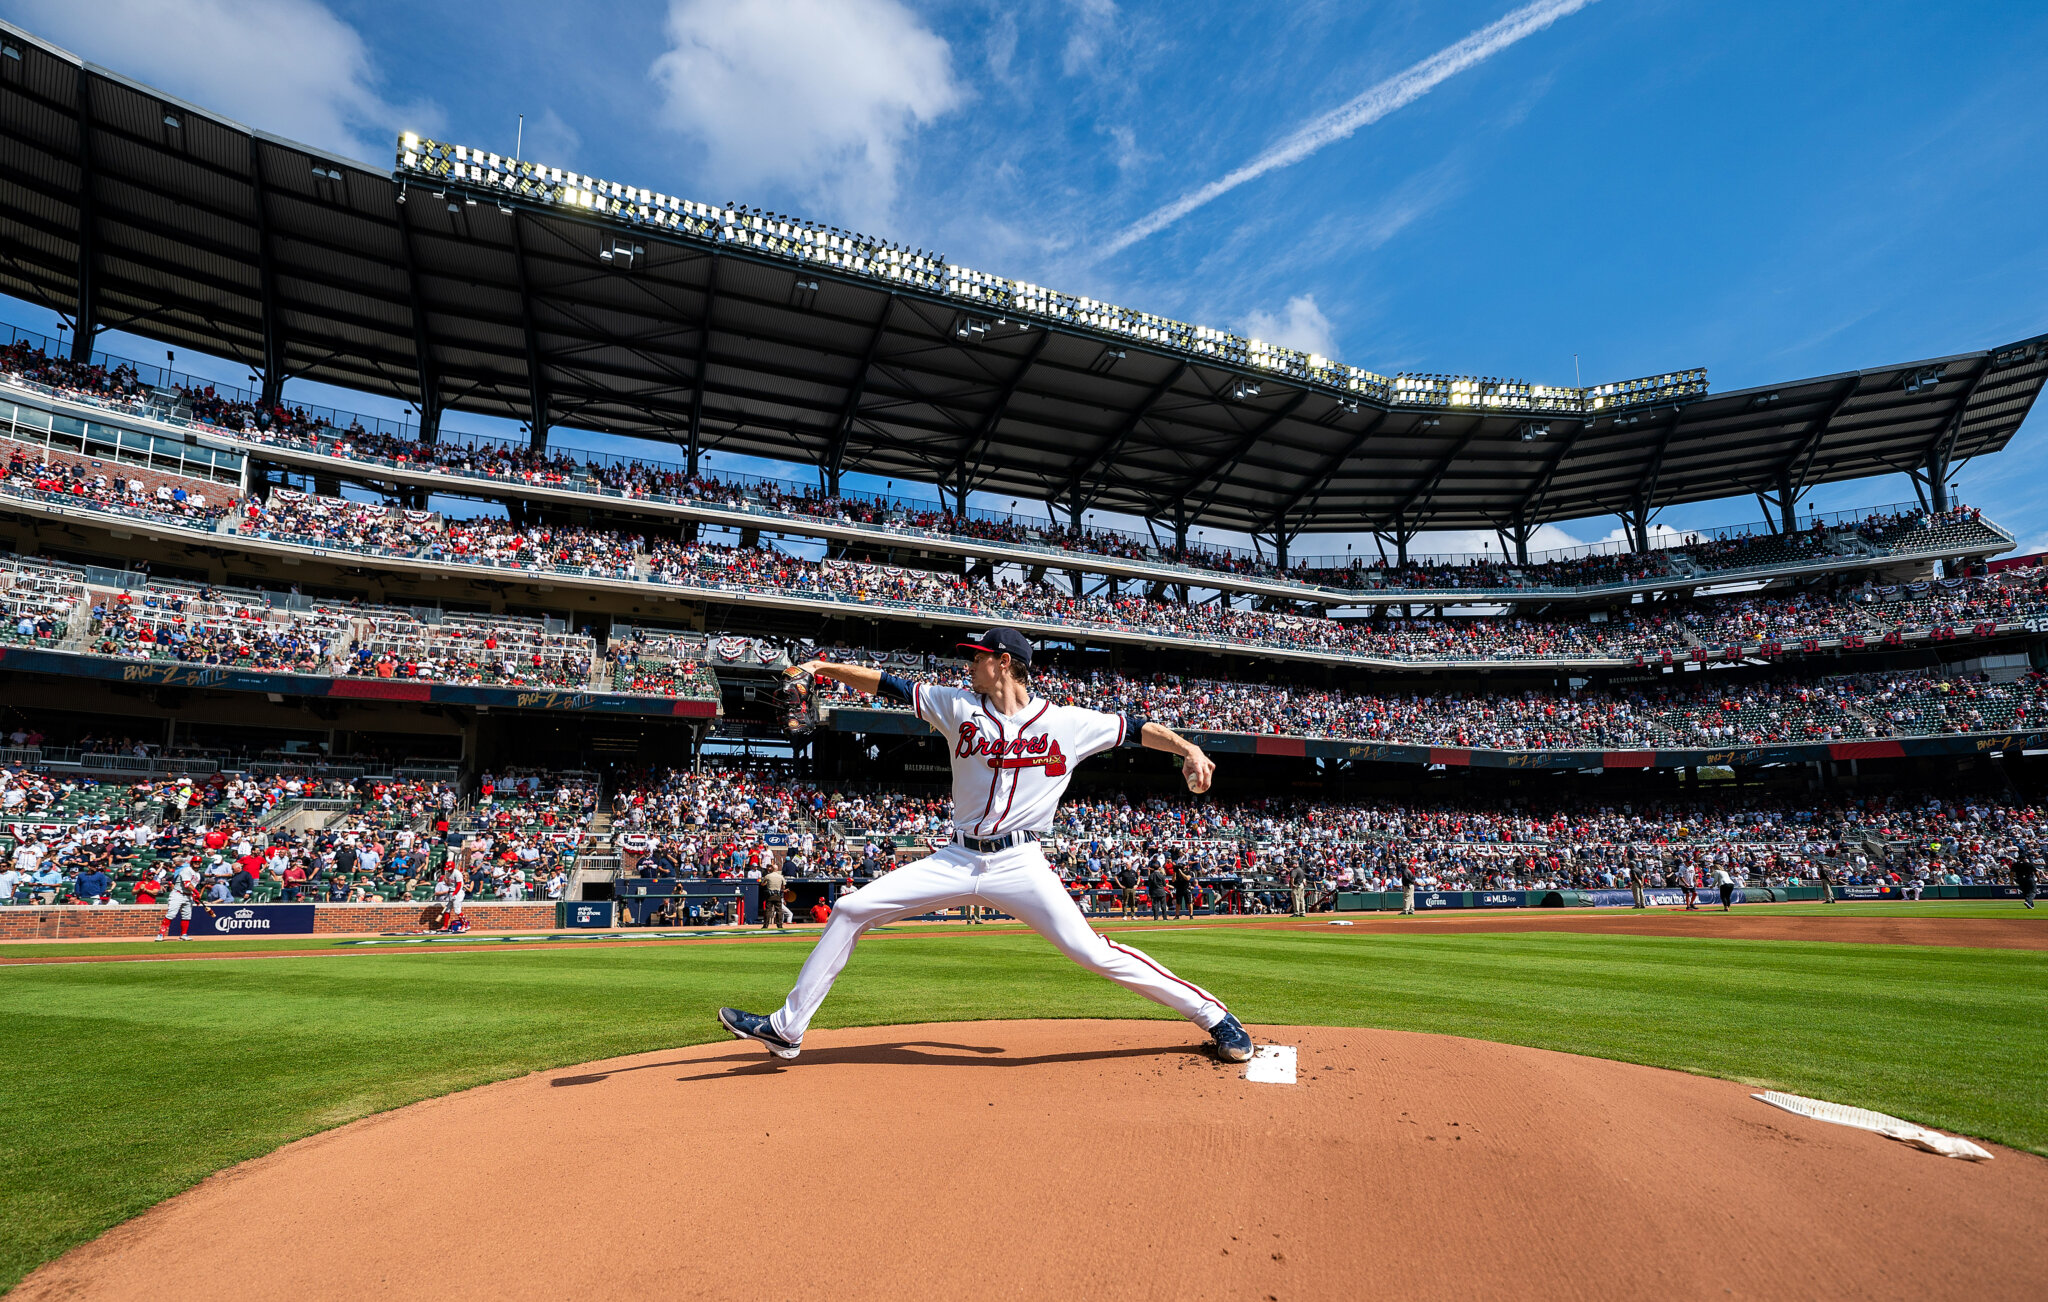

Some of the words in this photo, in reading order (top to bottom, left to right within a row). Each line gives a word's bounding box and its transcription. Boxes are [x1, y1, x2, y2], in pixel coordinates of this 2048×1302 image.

[1973, 623, 1997, 637] 47
[2024, 618, 2048, 633] 42
[1884, 631, 1904, 645] 41
[1930, 626, 1957, 641] 44
[1801, 640, 1821, 652] 31
[1842, 635, 1865, 649] 35
[1691, 649, 1708, 662] 10
[1726, 646, 1745, 660] 21
[1760, 643, 1783, 656] 29
[1634, 656, 1644, 667] 3
[1664, 652, 1673, 664] 6
[123, 664, 161, 681] BACK
[160, 666, 187, 684] 2
[185, 669, 231, 686] BATTLE
[517, 691, 544, 707] BACK
[544, 692, 564, 709] 2
[563, 694, 597, 710] BATTLE
[955, 721, 1048, 759] Braves
[1976, 737, 1998, 751] BACK
[2001, 736, 2018, 750] 2
[1725, 751, 1739, 764] 2
[904, 763, 934, 771] BALLPARK
[1425, 897, 1447, 907] Corona
[1492, 894, 1508, 903] MLB
[214, 916, 271, 933] Corona
